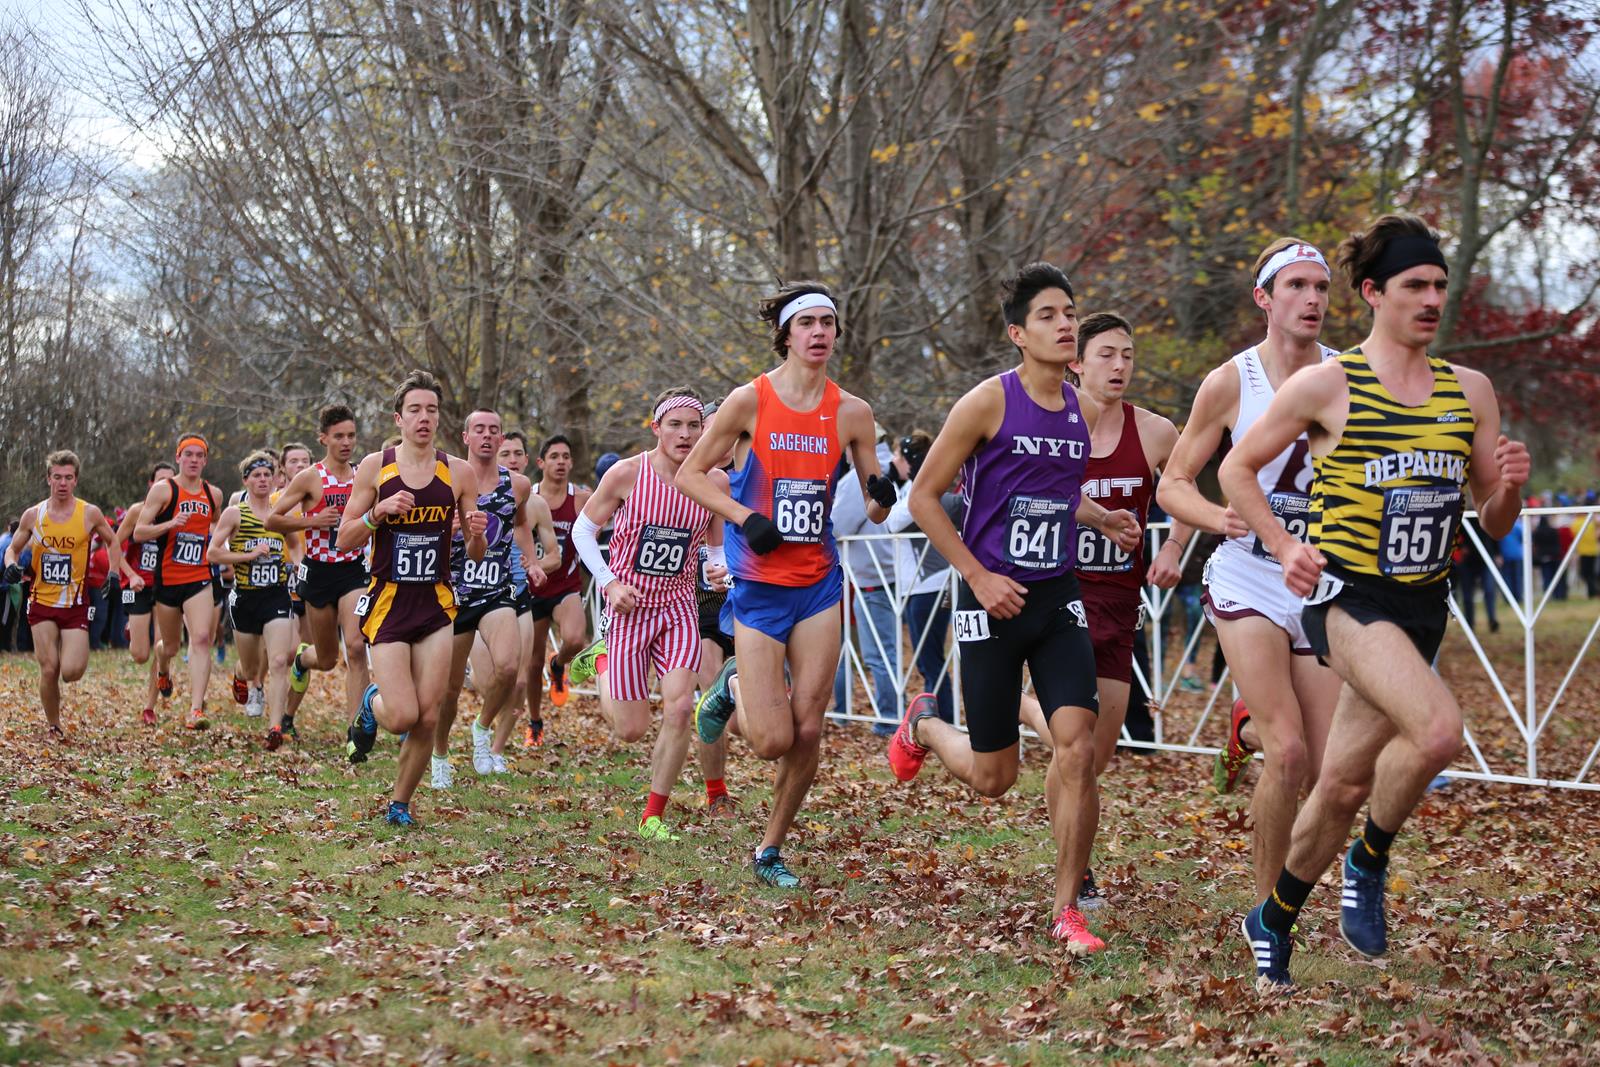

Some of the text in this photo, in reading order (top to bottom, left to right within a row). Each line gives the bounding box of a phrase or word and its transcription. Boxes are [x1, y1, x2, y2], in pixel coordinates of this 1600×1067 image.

[769, 432, 828, 455] SAGEHENS
[1012, 435, 1084, 459] NYU
[1364, 451, 1466, 488] DEPAUW
[180, 501, 209, 517] RIT
[777, 499, 824, 534] 683
[41, 535, 75, 549] CMS
[176, 541, 202, 562] 700
[1009, 519, 1061, 560] 641
[1386, 515, 1452, 563] 551
[397, 549, 437, 575] 512
[639, 541, 684, 572] 629
[43, 563, 69, 581] 544
[251, 565, 279, 584] 550
[463, 559, 500, 585] 840
[956, 613, 982, 638] 641
